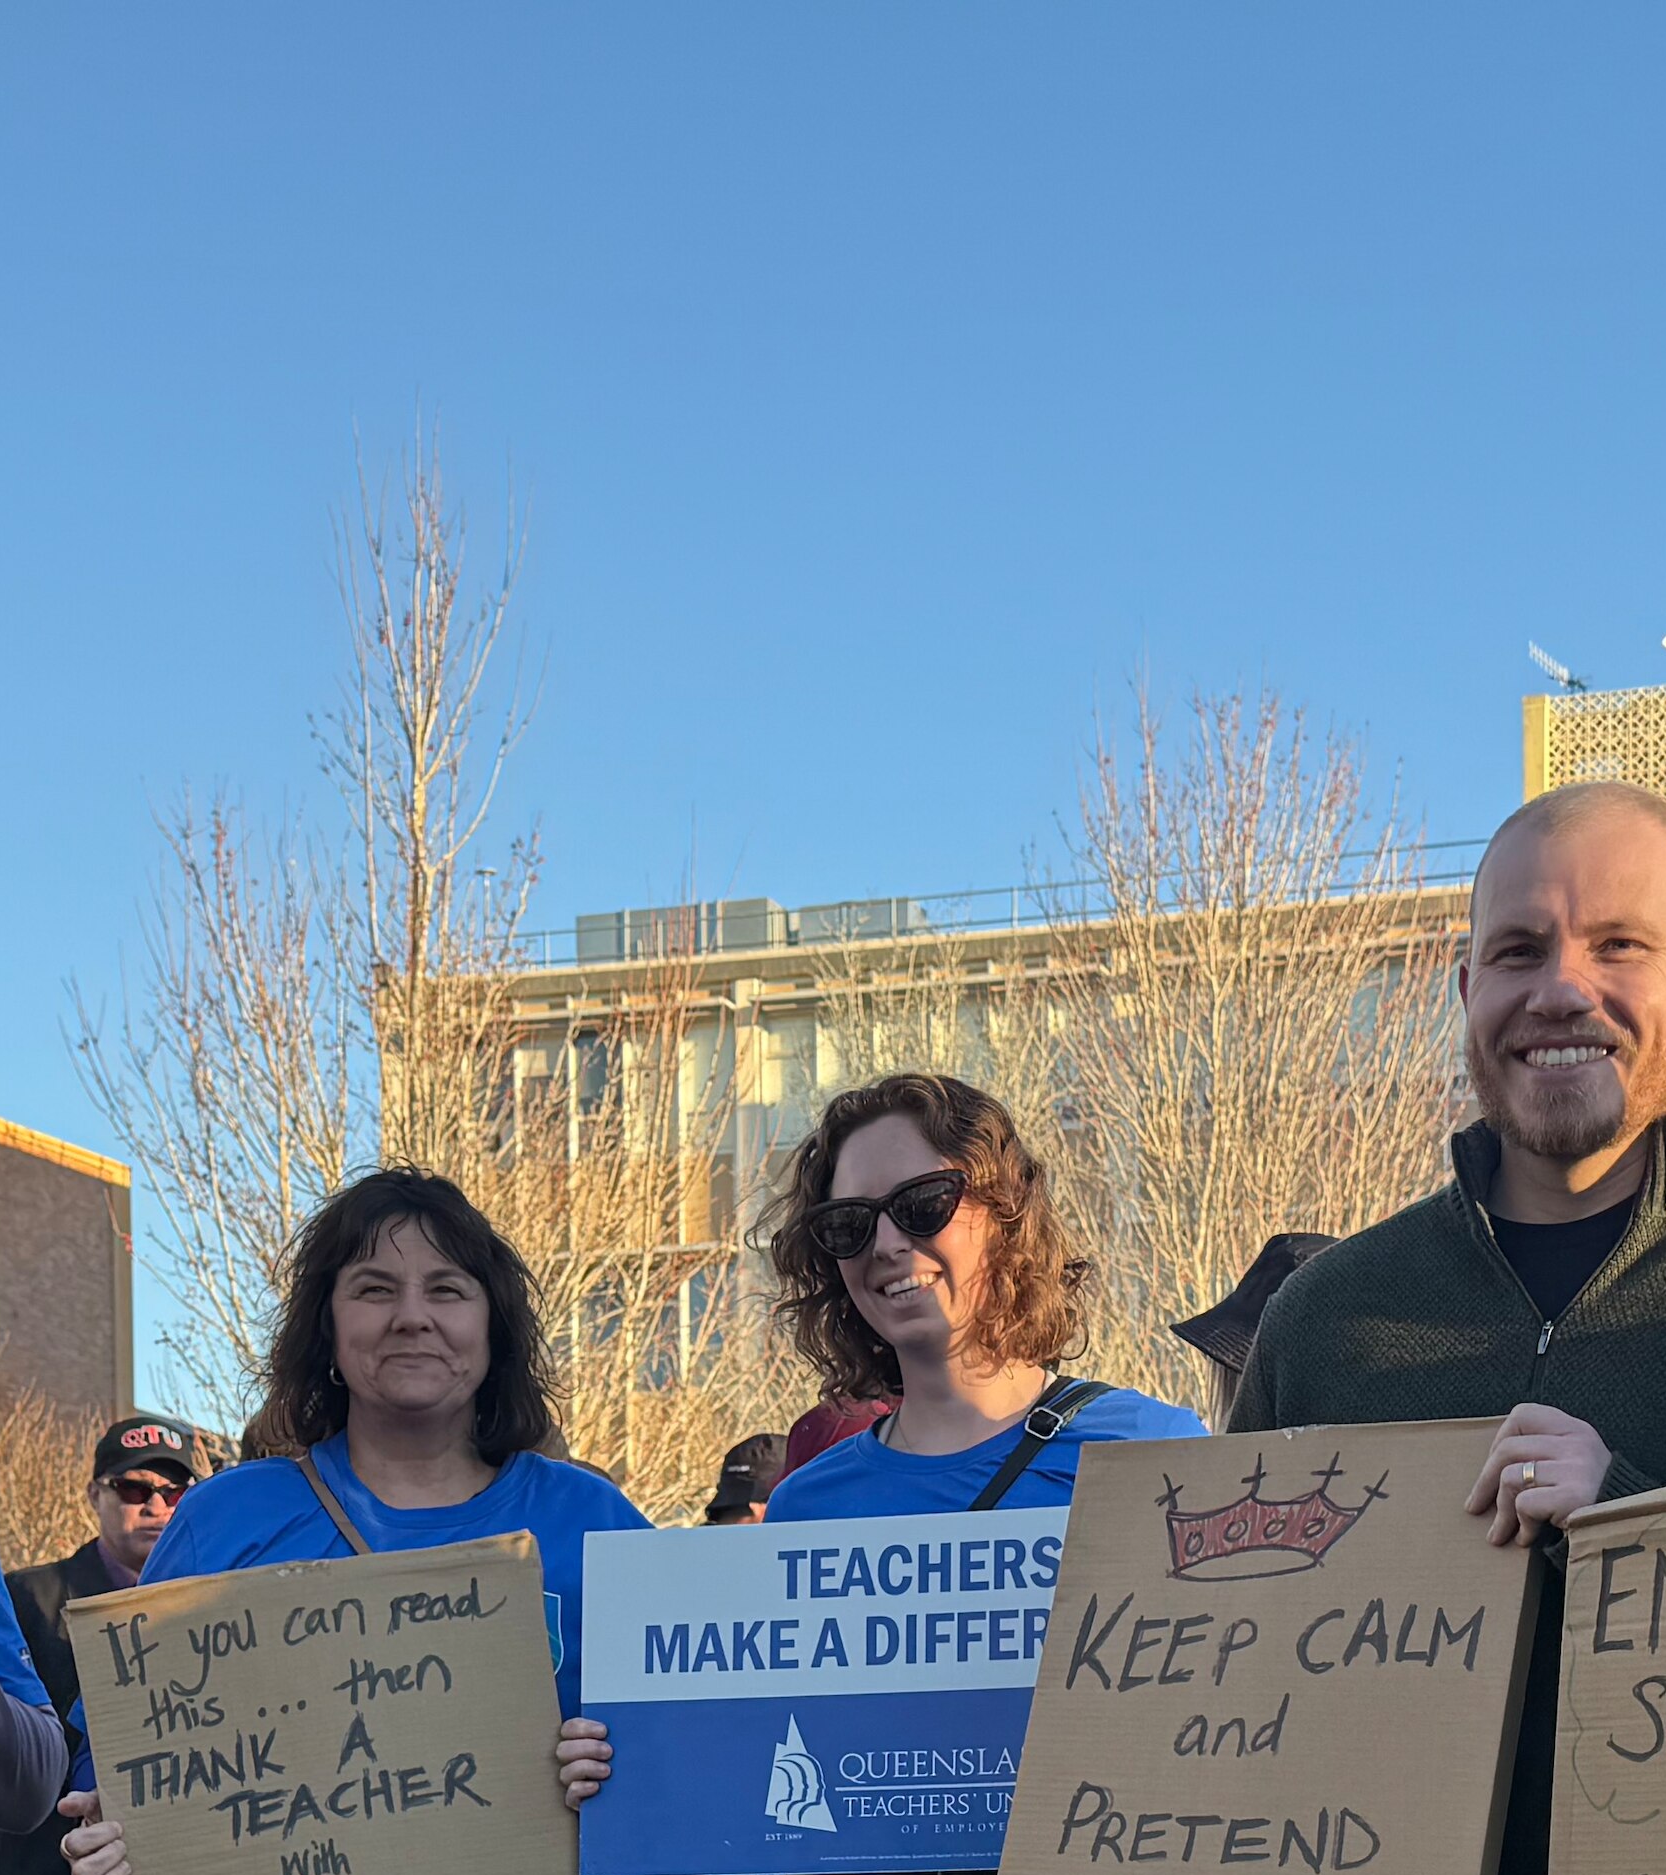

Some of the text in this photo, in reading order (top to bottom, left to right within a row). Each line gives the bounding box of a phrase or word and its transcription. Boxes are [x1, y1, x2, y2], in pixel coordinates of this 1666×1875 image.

[121, 1424, 183, 1450] QTU
[777, 1535, 1064, 1600] TEACHERS
[98, 1577, 507, 1697] If you can read
[644, 1608, 1052, 1674] MAKE A DIFFER
[1065, 1592, 1486, 1692] KEEP CALM
[333, 1654, 453, 1705] then
[1173, 1693, 1290, 1757] and
[116, 1709, 376, 1809] THANK A
[838, 1747, 1023, 1784] QUEENSLA
[209, 1752, 493, 1847] TEACHER
[843, 1792, 979, 1818] TEACHERS'
[901, 1823, 920, 1835] OF
[1056, 1781, 1381, 1875] PRETEND
